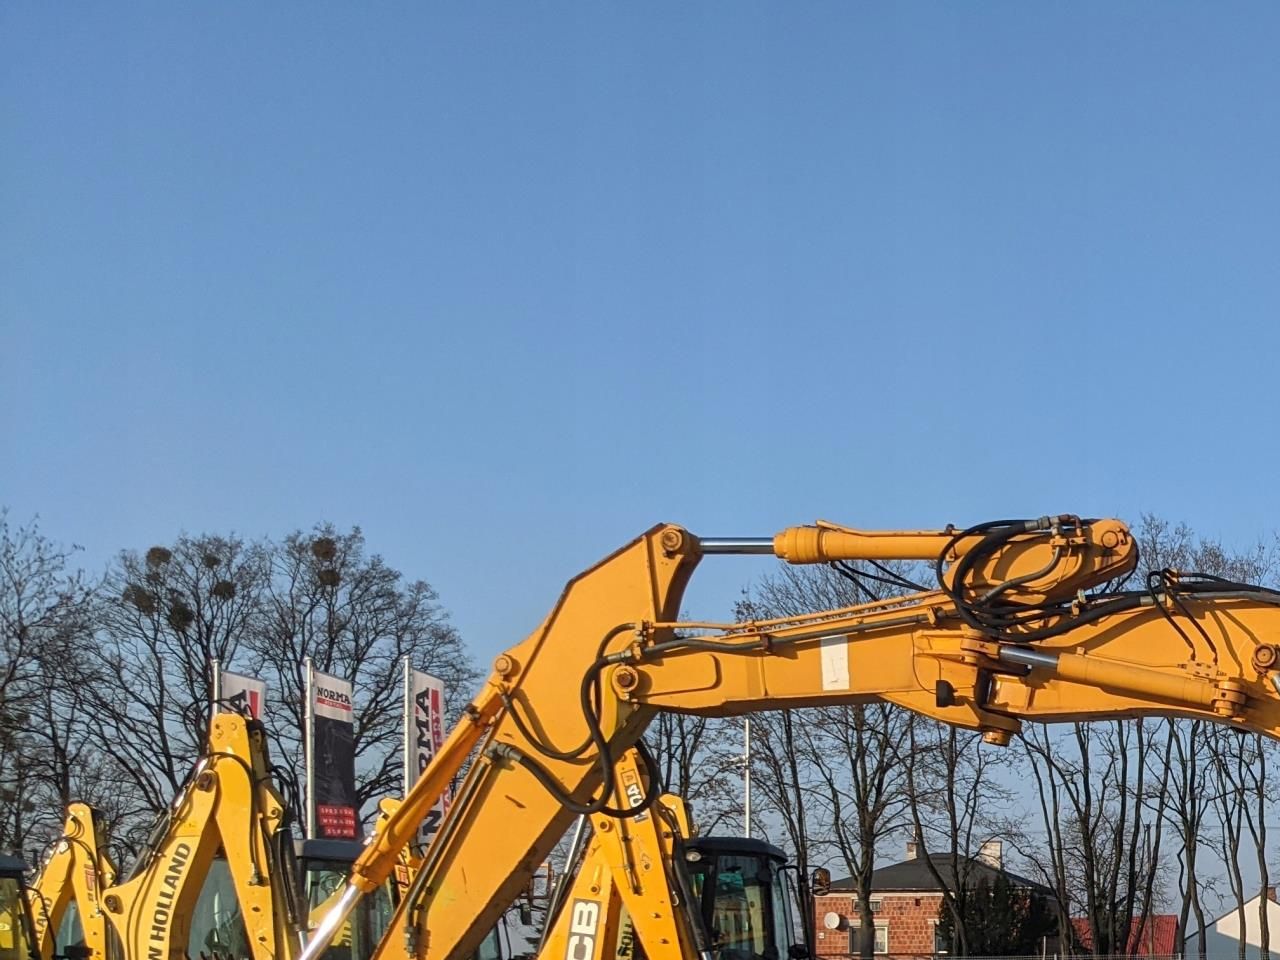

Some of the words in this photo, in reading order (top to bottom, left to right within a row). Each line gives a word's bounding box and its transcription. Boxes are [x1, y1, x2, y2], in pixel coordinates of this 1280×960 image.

[317, 686, 351, 704] NORMA
[415, 687, 442, 836] NRMA
[150, 843, 191, 942] HOLLAND
